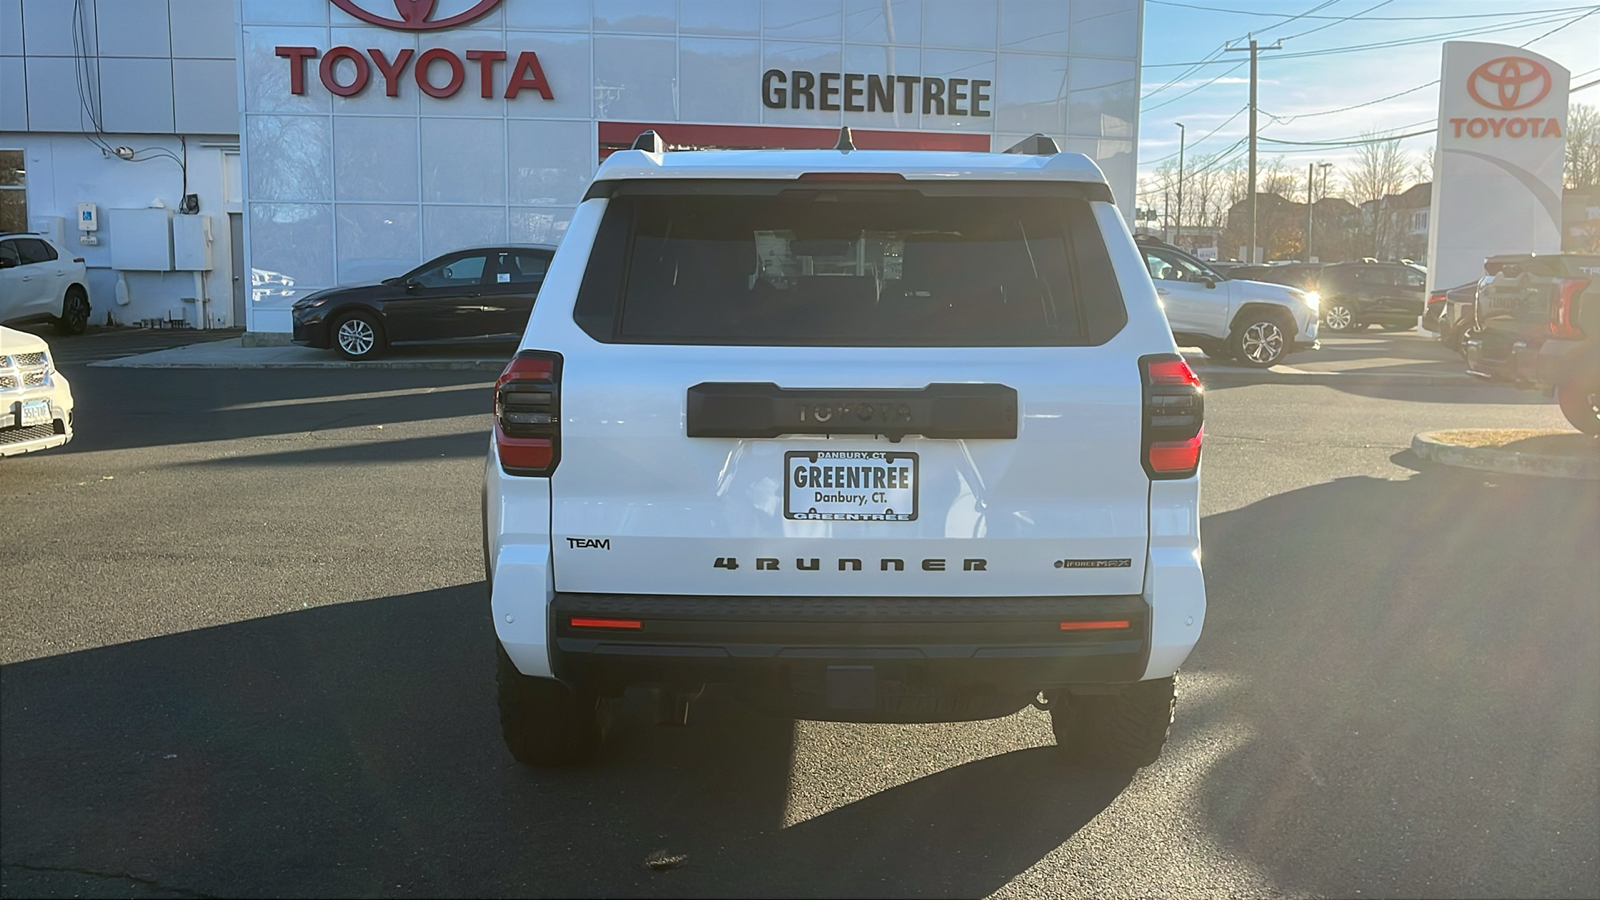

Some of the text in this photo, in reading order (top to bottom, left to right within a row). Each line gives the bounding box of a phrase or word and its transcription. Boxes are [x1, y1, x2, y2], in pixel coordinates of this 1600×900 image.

[275, 46, 555, 100] TOYOTA
[762, 69, 991, 117] GREENTREE
[1449, 117, 1562, 138] TOYOTA
[797, 403, 912, 422] TOYOTA
[817, 452, 869, 460] DANBURY,
[794, 466, 909, 488] GREENTREE
[814, 491, 888, 506] Danbury, CT.
[793, 513, 910, 521] GREENTREE
[566, 537, 610, 550] TEAM
